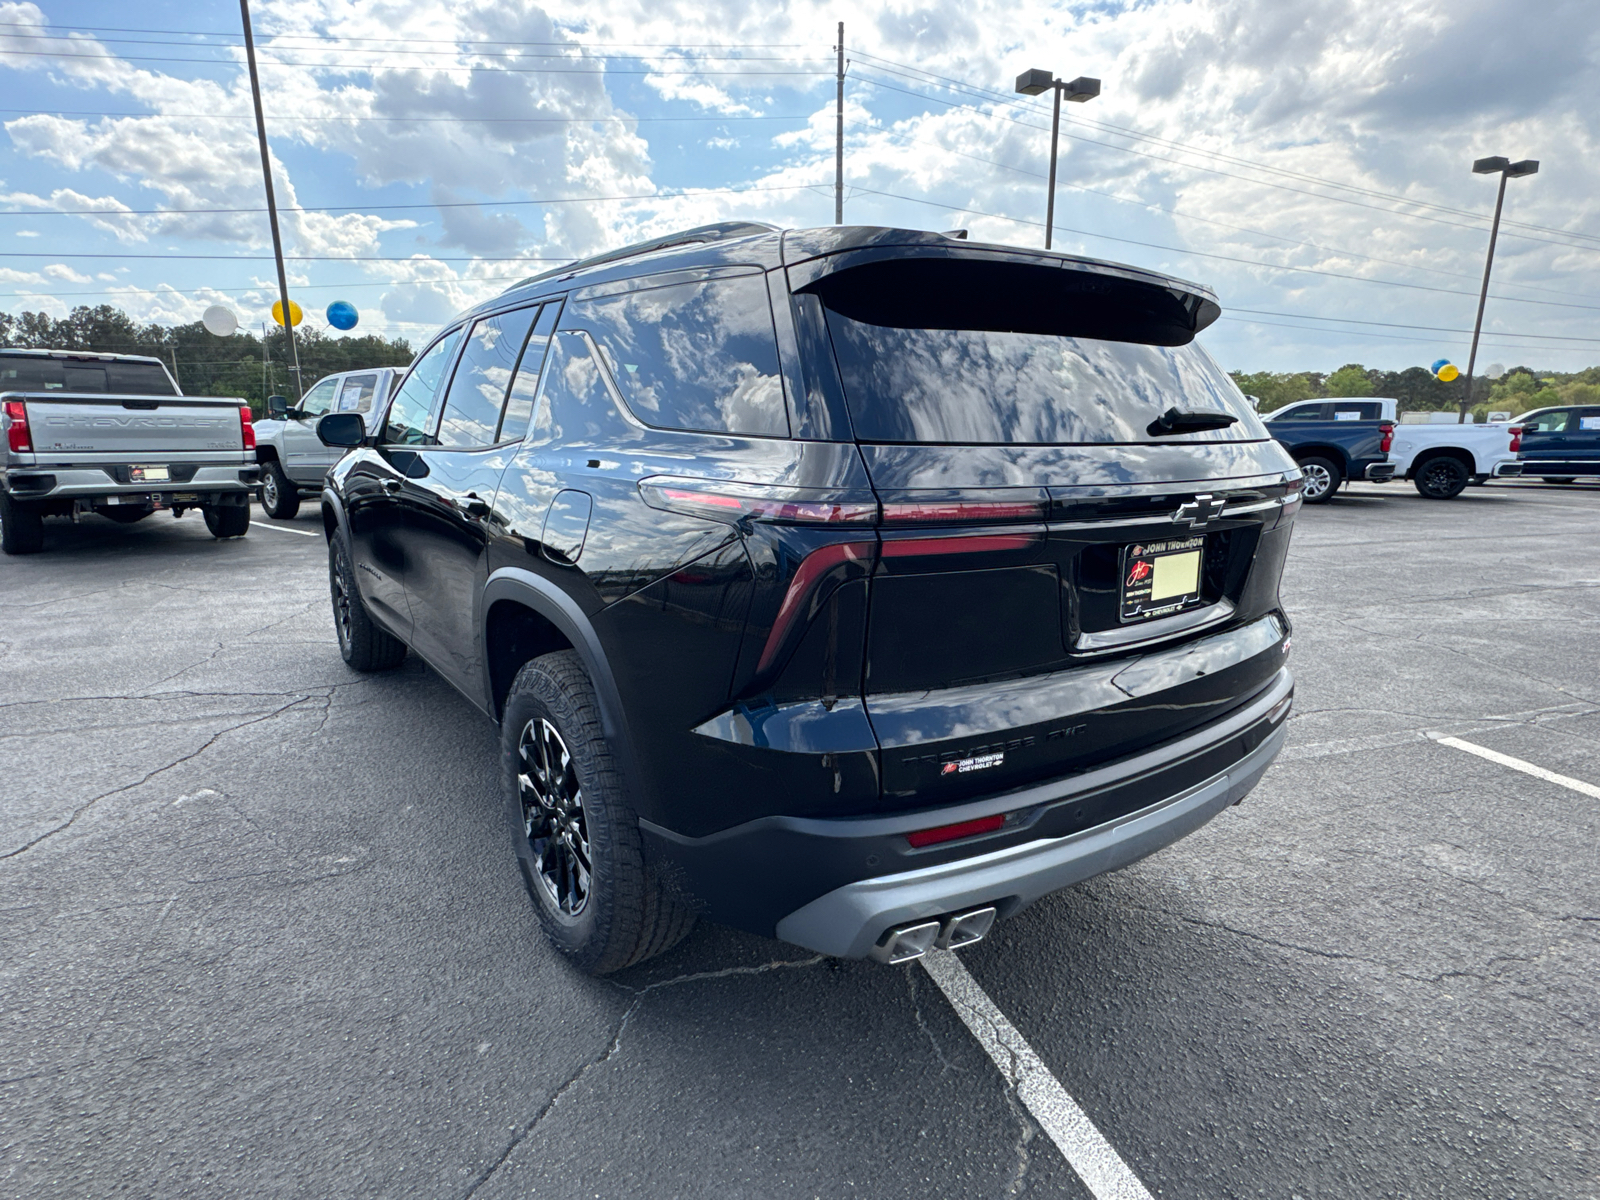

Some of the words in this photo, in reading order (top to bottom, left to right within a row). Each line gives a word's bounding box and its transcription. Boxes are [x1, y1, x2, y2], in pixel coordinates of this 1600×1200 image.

[45, 416, 228, 428] CHEVROLET
[1146, 542, 1167, 554] JOHN
[1167, 537, 1204, 551] THORNTON
[1152, 606, 1176, 616] CHEVROLET
[958, 758, 974, 767] JOHN
[975, 752, 1004, 764] THORNTON
[958, 761, 993, 773] CHEVROLET
